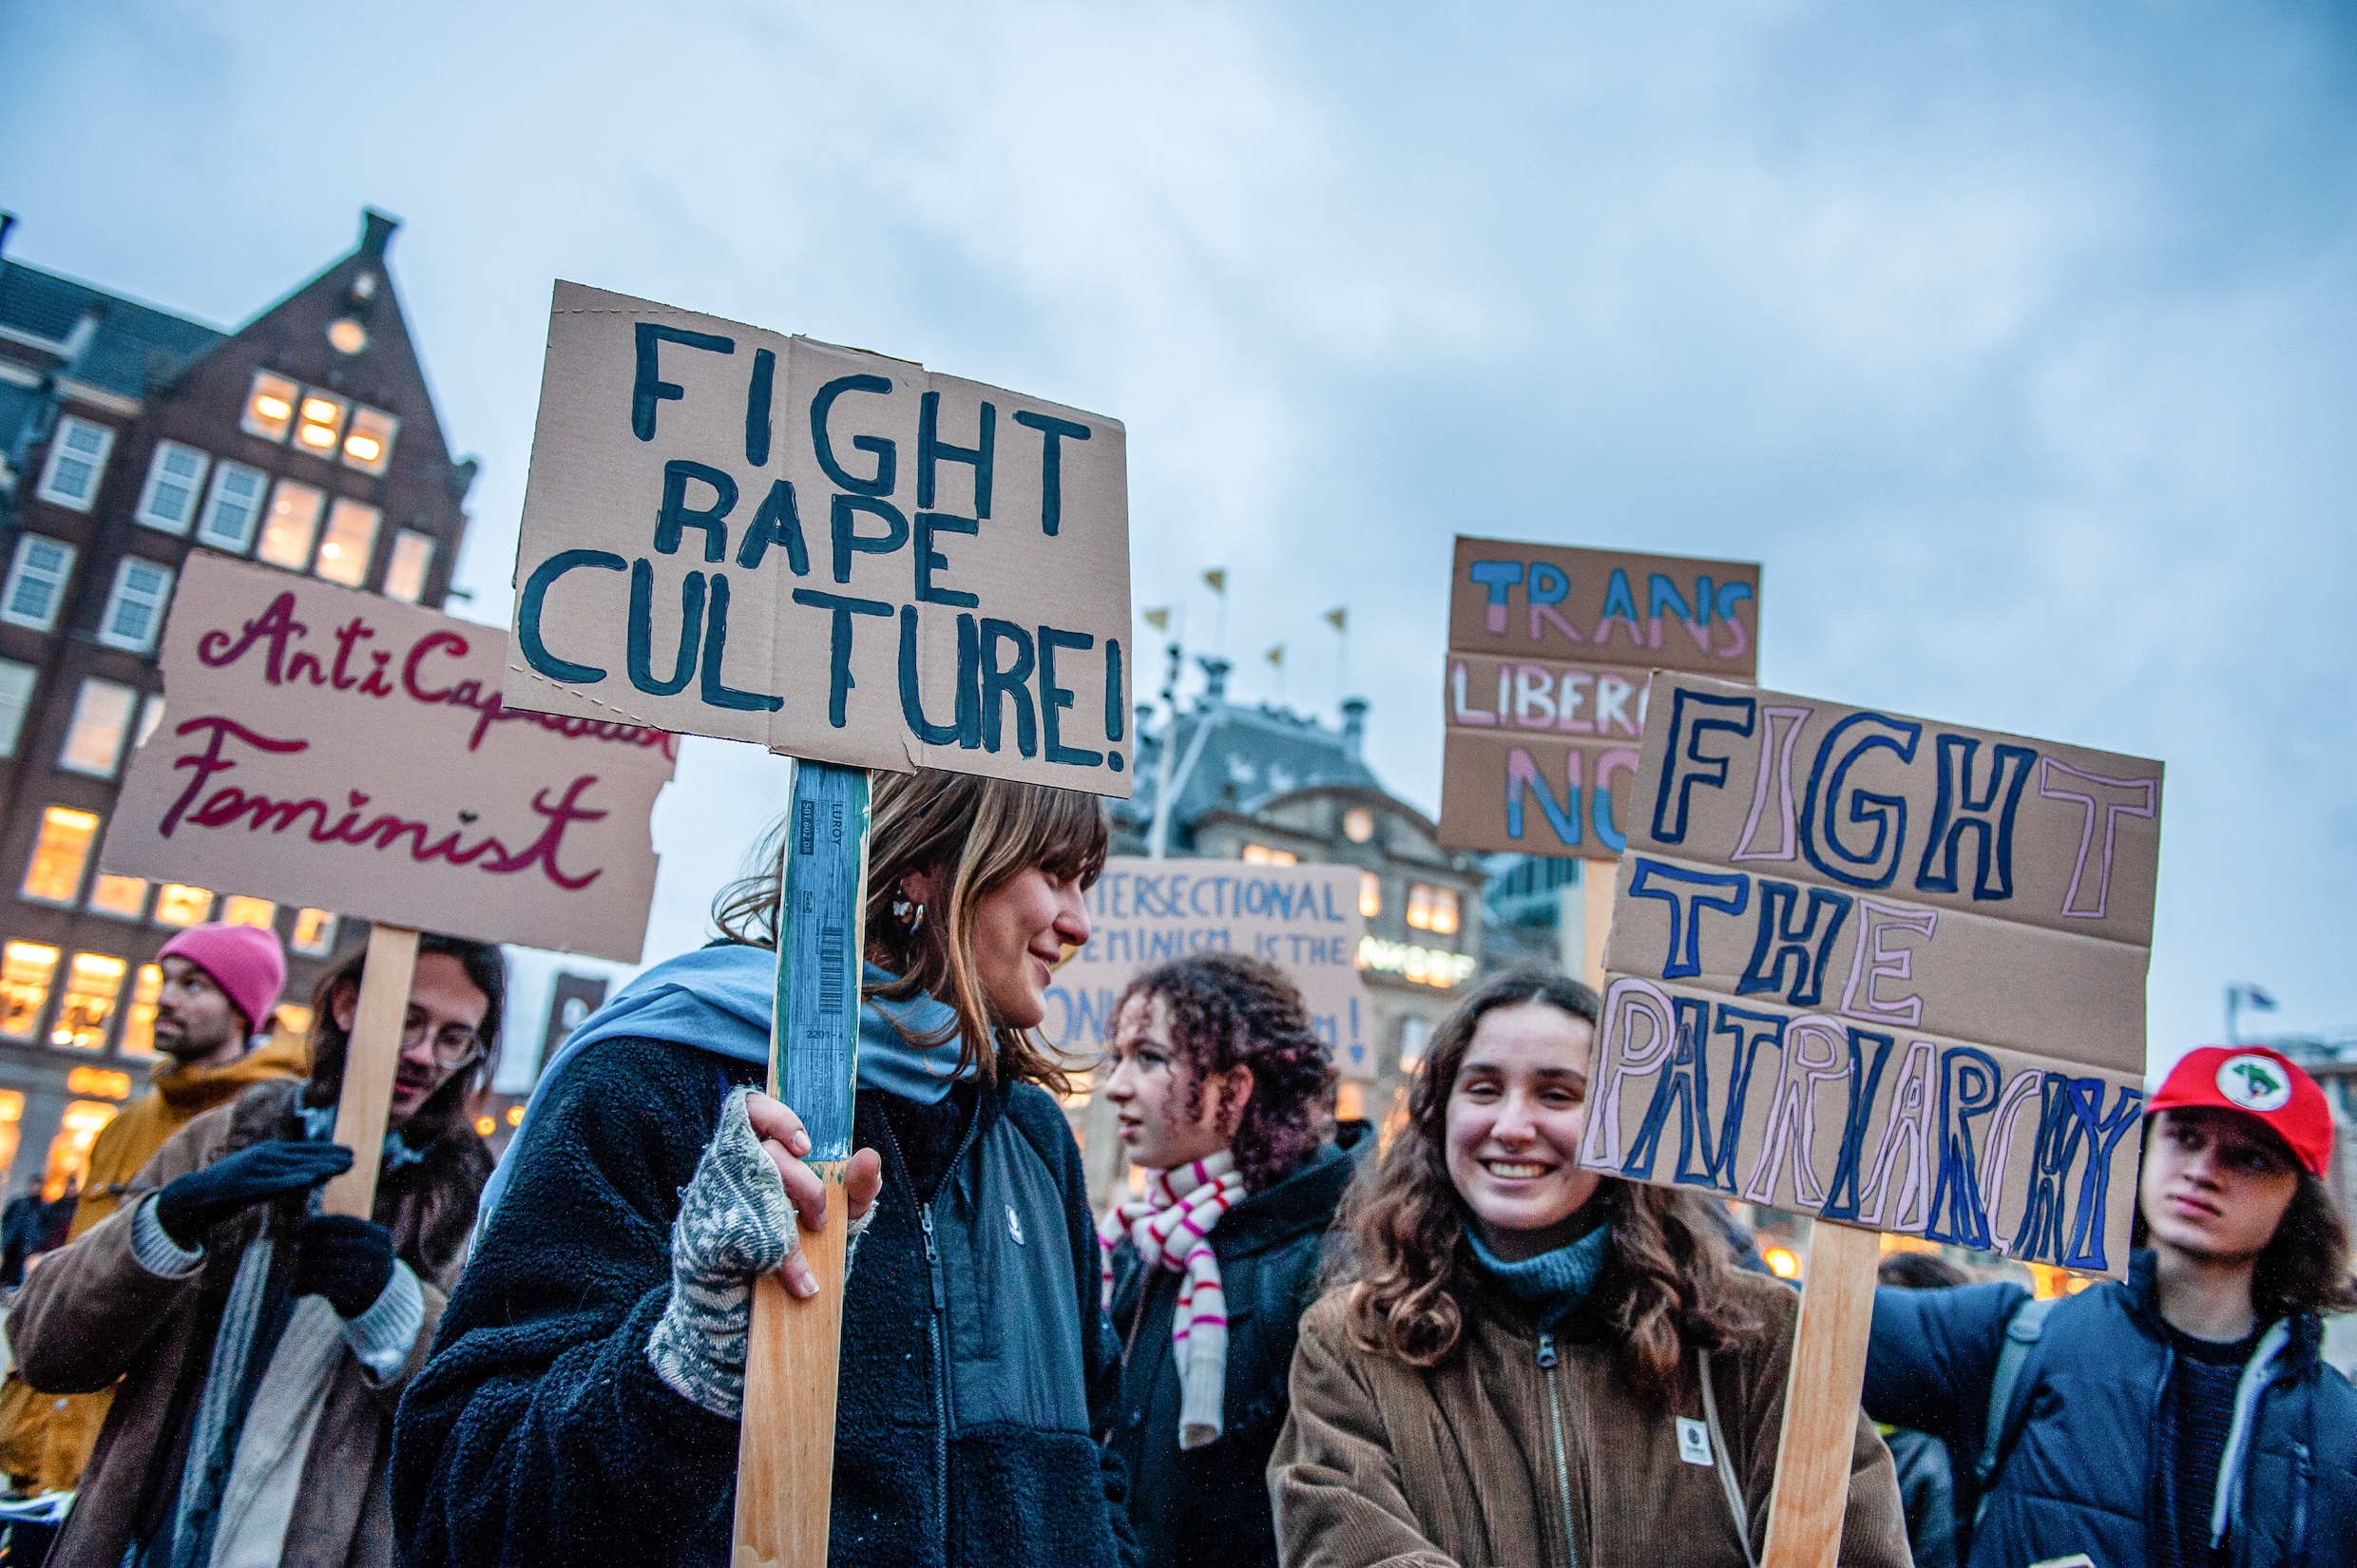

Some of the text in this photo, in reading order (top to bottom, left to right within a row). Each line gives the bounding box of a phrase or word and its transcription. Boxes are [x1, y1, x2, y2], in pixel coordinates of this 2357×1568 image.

[632, 322, 1091, 536] FIGHT
[654, 460, 979, 607] RAPE
[1470, 560, 1753, 659] TRANS
[198, 591, 677, 762] AntiCap
[518, 548, 1123, 772] CULTURE!
[159, 716, 608, 889] Feminist
[802, 802, 812, 853] 501.602.08
[832, 803, 845, 846] LURÖY
[1652, 688, 2157, 918] FIGHT
[1085, 871, 1345, 922] TERSECTIONAL
[1287, 932, 1347, 966] THE
[1630, 857, 1938, 1026] THE
[806, 1029, 844, 1040] 2201-4
[1577, 977, 2144, 1271] PATRIARCHY
